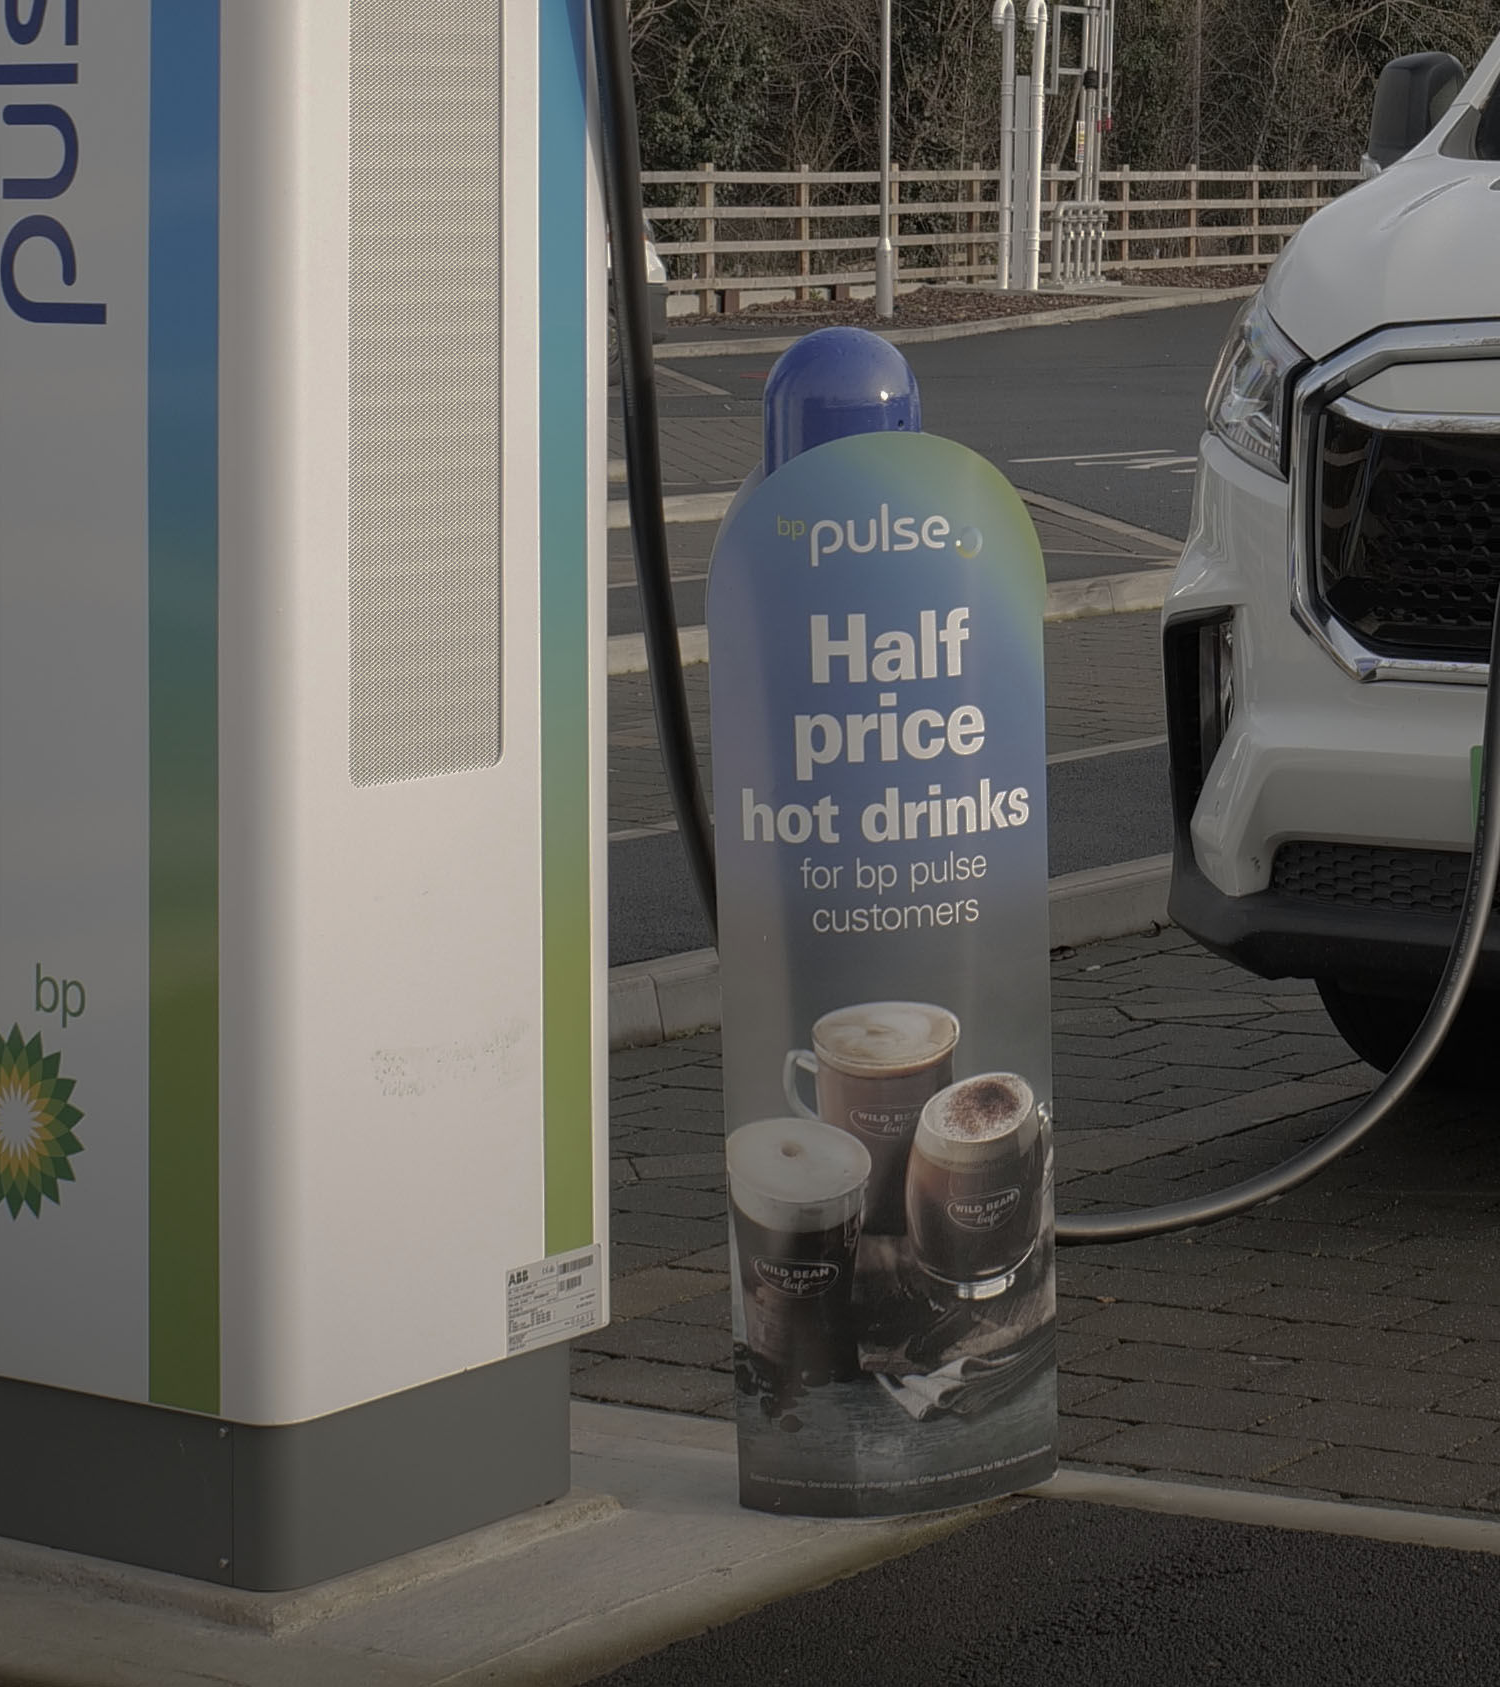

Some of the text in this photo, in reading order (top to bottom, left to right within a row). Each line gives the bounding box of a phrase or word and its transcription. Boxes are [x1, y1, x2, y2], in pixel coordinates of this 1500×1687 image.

[777, 503, 950, 567] bp pulse
[810, 607, 970, 684] Half
[795, 693, 985, 781] price
[741, 778, 1030, 844] hot drinks
[800, 852, 988, 894] for bp pulse
[812, 897, 980, 933] customers
[35, 963, 87, 1028] bp
[858, 1111, 889, 1123] WILD
[955, 1193, 1015, 1214] WILD BEAN
[508, 1269, 529, 1287] ABB
[760, 1261, 829, 1279] WILD BEAN
